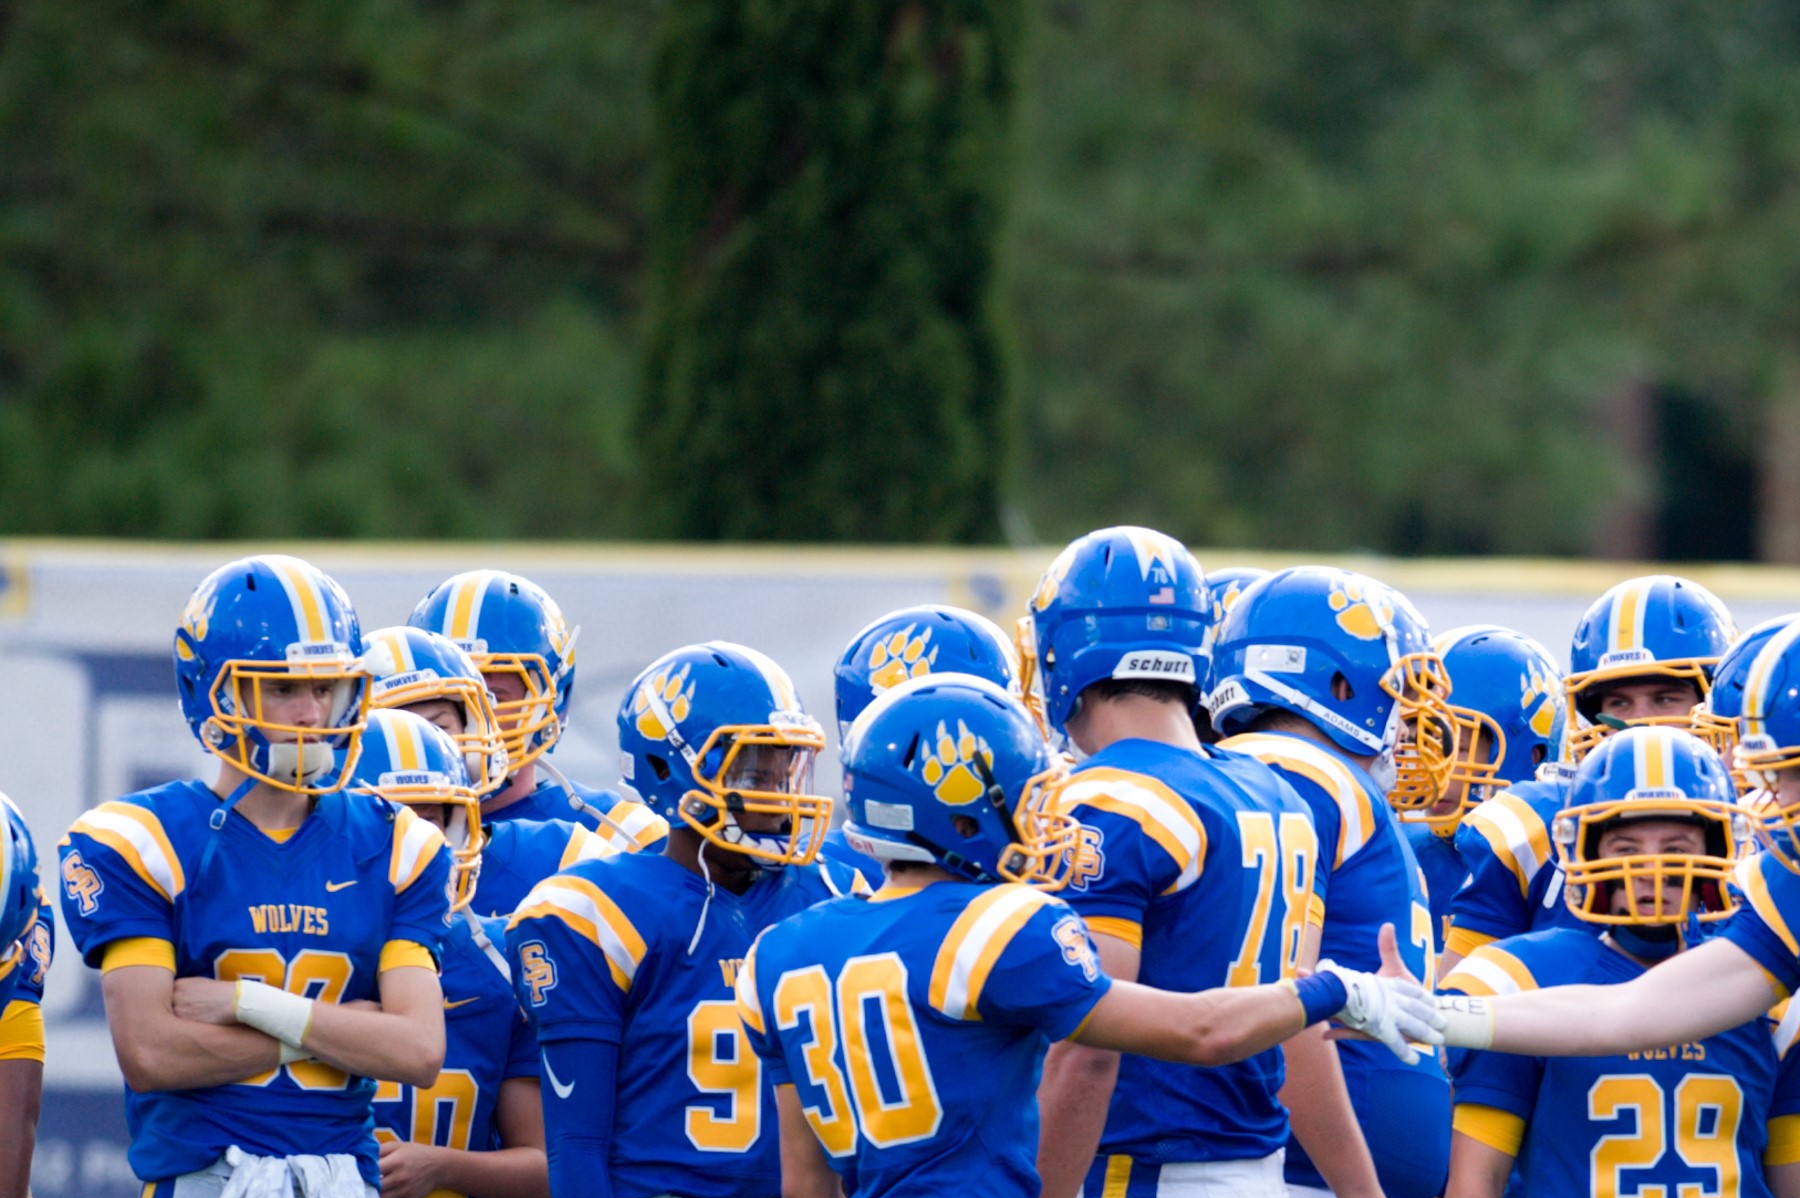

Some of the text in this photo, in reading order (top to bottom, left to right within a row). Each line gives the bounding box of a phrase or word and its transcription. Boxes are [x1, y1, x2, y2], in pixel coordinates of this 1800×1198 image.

[1128, 657, 1191, 675] schutt
[1609, 651, 1642, 662] WOLVES
[384, 674, 419, 690] WOLVES
[1323, 711, 1361, 738] ADAMS
[395, 774, 430, 785] WOLVES
[1224, 811, 1318, 987] 78
[248, 904, 329, 936] WOLVES
[773, 951, 944, 1158] 30
